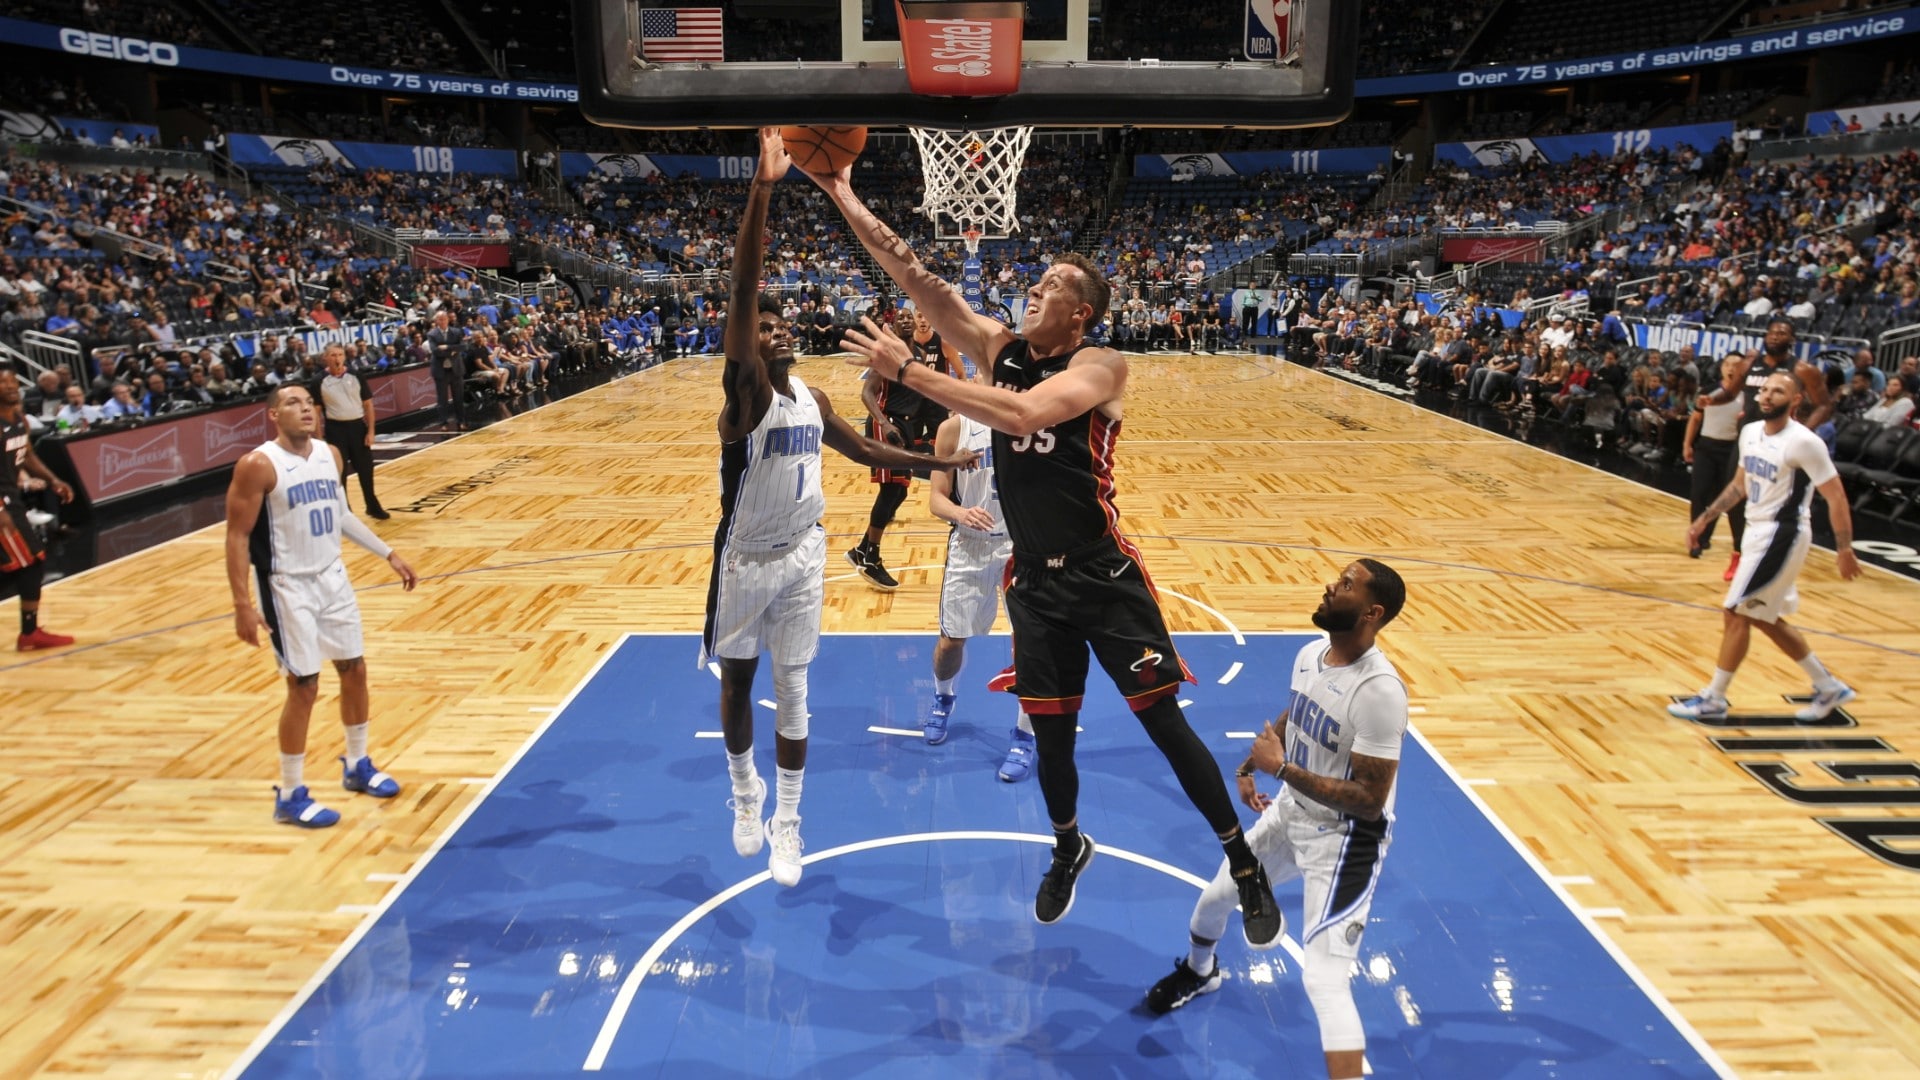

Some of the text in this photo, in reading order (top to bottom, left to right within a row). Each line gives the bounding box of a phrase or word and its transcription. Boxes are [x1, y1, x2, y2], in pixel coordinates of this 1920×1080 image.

[59, 27, 179, 66] GEICO
[1251, 37, 1272, 54] NBA
[1458, 16, 1905, 87] Over 75 years of savings and service
[330, 66, 383, 86] Over
[390, 73, 421, 89] 75
[428, 79, 484, 93] years
[490, 82, 510, 95] of
[1612, 129, 1651, 154] 112
[412, 146, 453, 172] 108
[718, 156, 754, 179] 109
[1291, 150, 1319, 174] 111
[1647, 325, 1698, 354] MAGIC
[1699, 331, 1765, 362] ABOV
[796, 463, 805, 501] 1
[309, 506, 333, 537] 00
